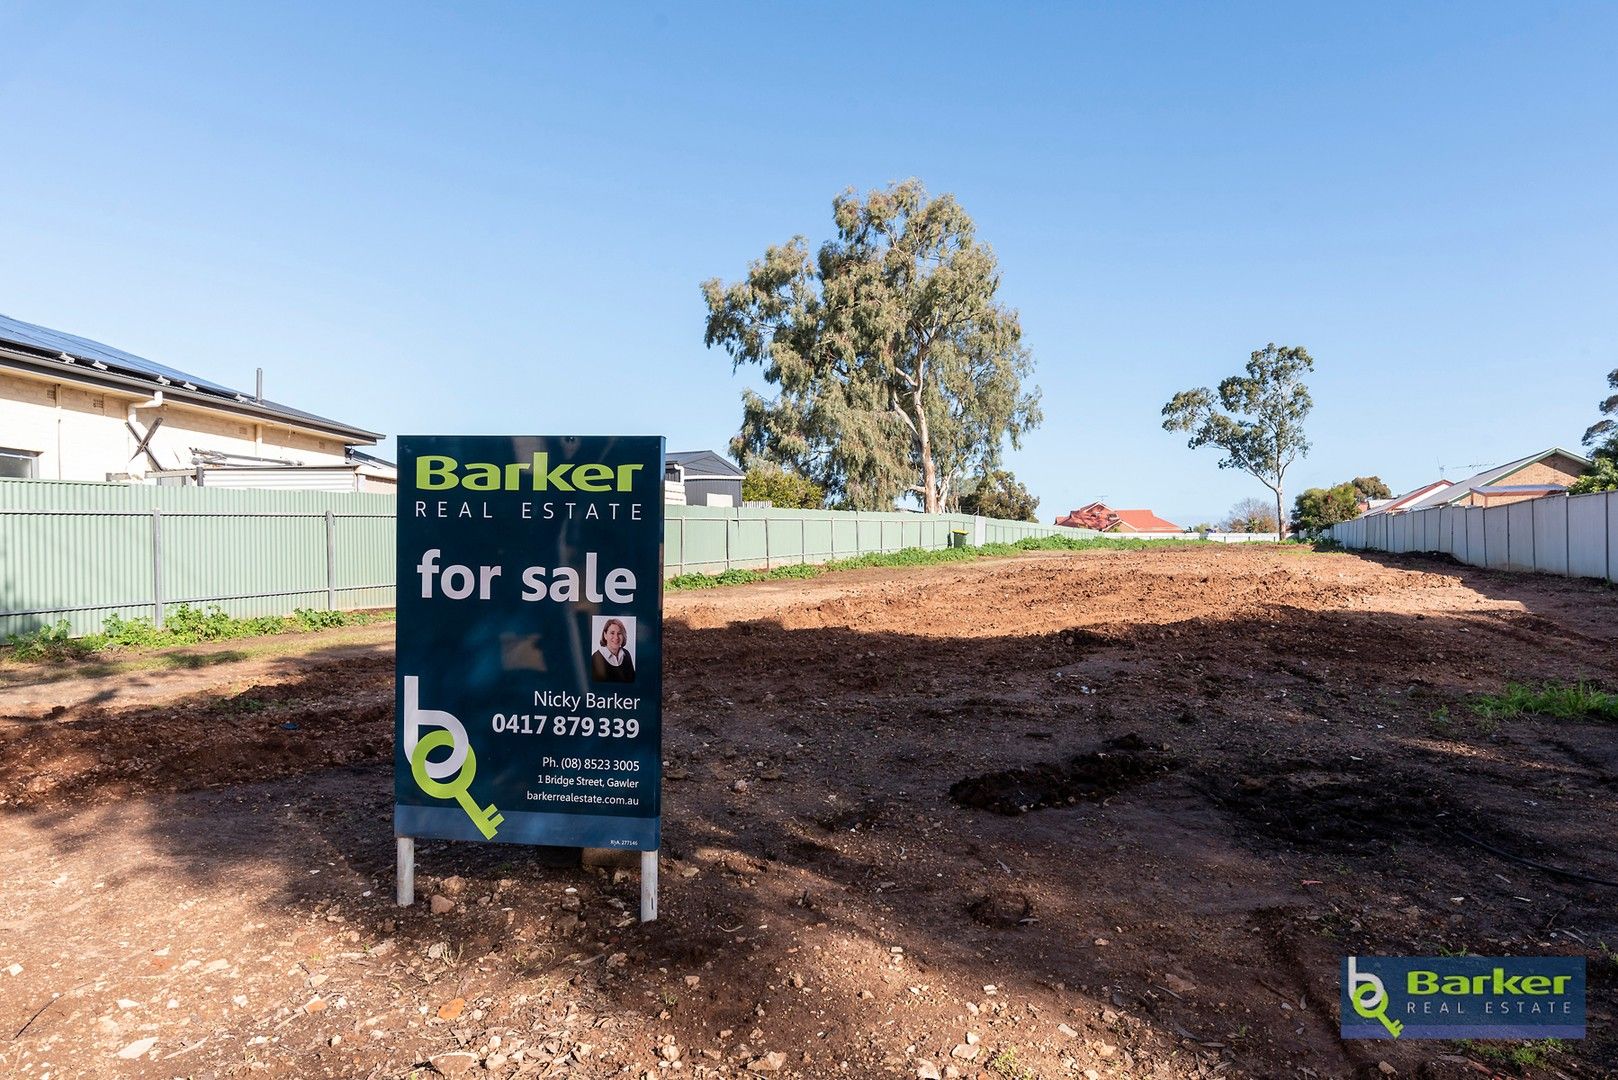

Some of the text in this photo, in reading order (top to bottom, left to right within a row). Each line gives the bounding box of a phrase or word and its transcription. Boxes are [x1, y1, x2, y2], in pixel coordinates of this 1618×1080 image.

[416, 452, 644, 492] Barker
[415, 501, 642, 521] REAL ESTATE
[416, 549, 637, 604] for sale
[534, 691, 641, 712] Nicky Barker
[492, 713, 640, 738] 0417 879 339
[542, 756, 640, 772] Ph. (08) 8523 3005
[537, 774, 639, 788] 1 Bridge Street, Gawler
[526, 790, 639, 805] barkerrealestate.com.au
